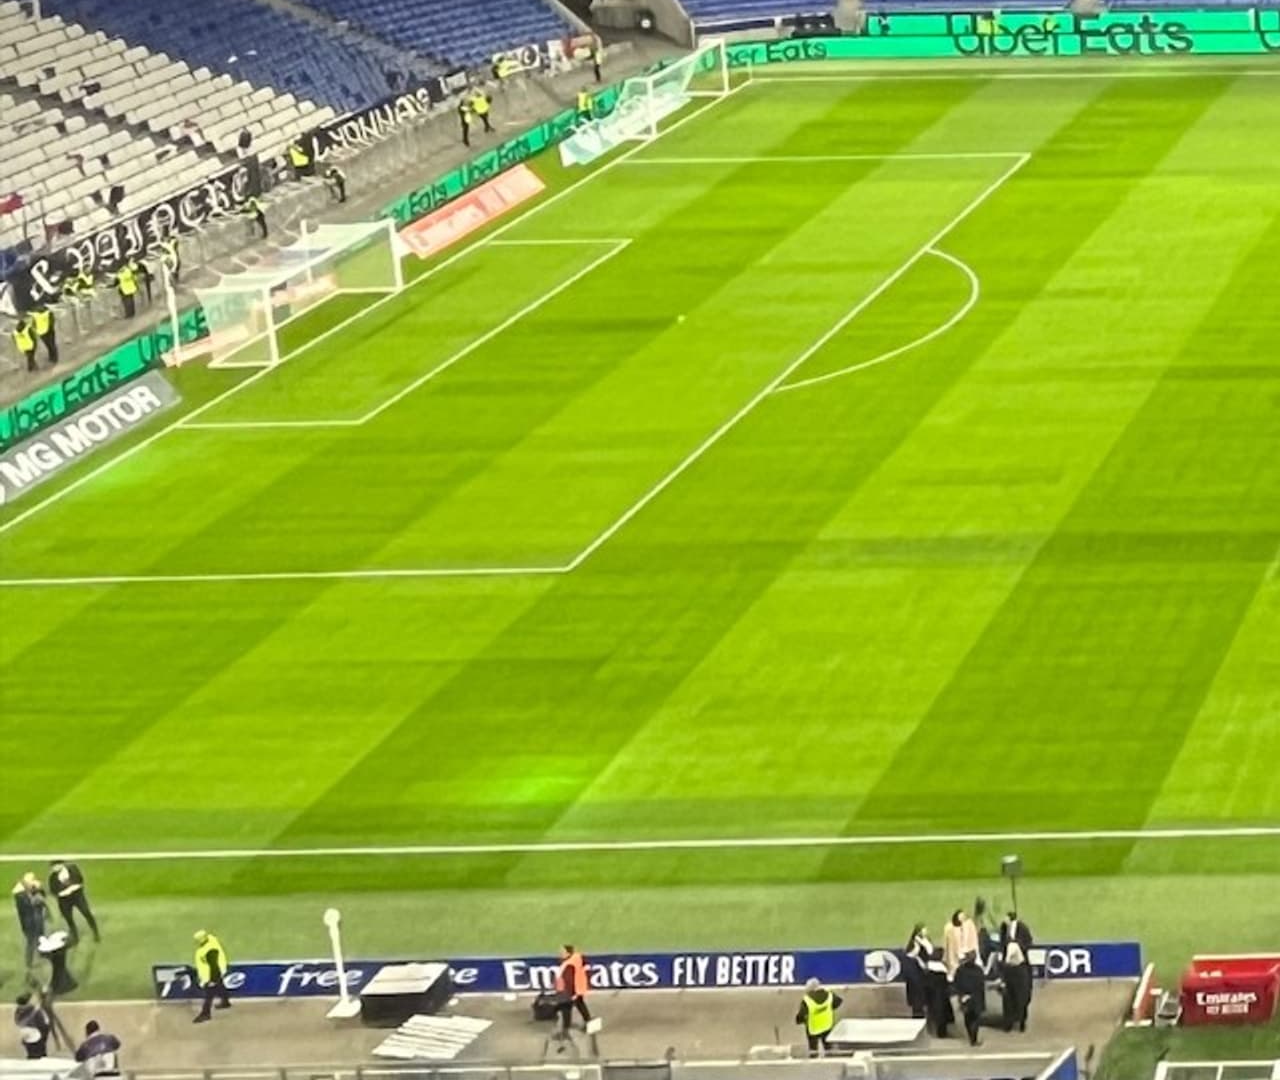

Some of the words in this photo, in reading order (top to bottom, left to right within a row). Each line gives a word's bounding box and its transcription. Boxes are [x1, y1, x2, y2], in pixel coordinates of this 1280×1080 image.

[766, 39, 827, 63] Eats
[952, 13, 1061, 56] Uber
[1075, 12, 1194, 56] Eats
[311, 86, 431, 162] LYONNAIS
[60, 358, 120, 406] Eats
[0, 441, 64, 489] MG
[49, 384, 161, 459] MOTOR
[672, 956, 710, 985] FLY
[715, 954, 796, 985] BETTER
[1196, 991, 1257, 1006] Emirates
